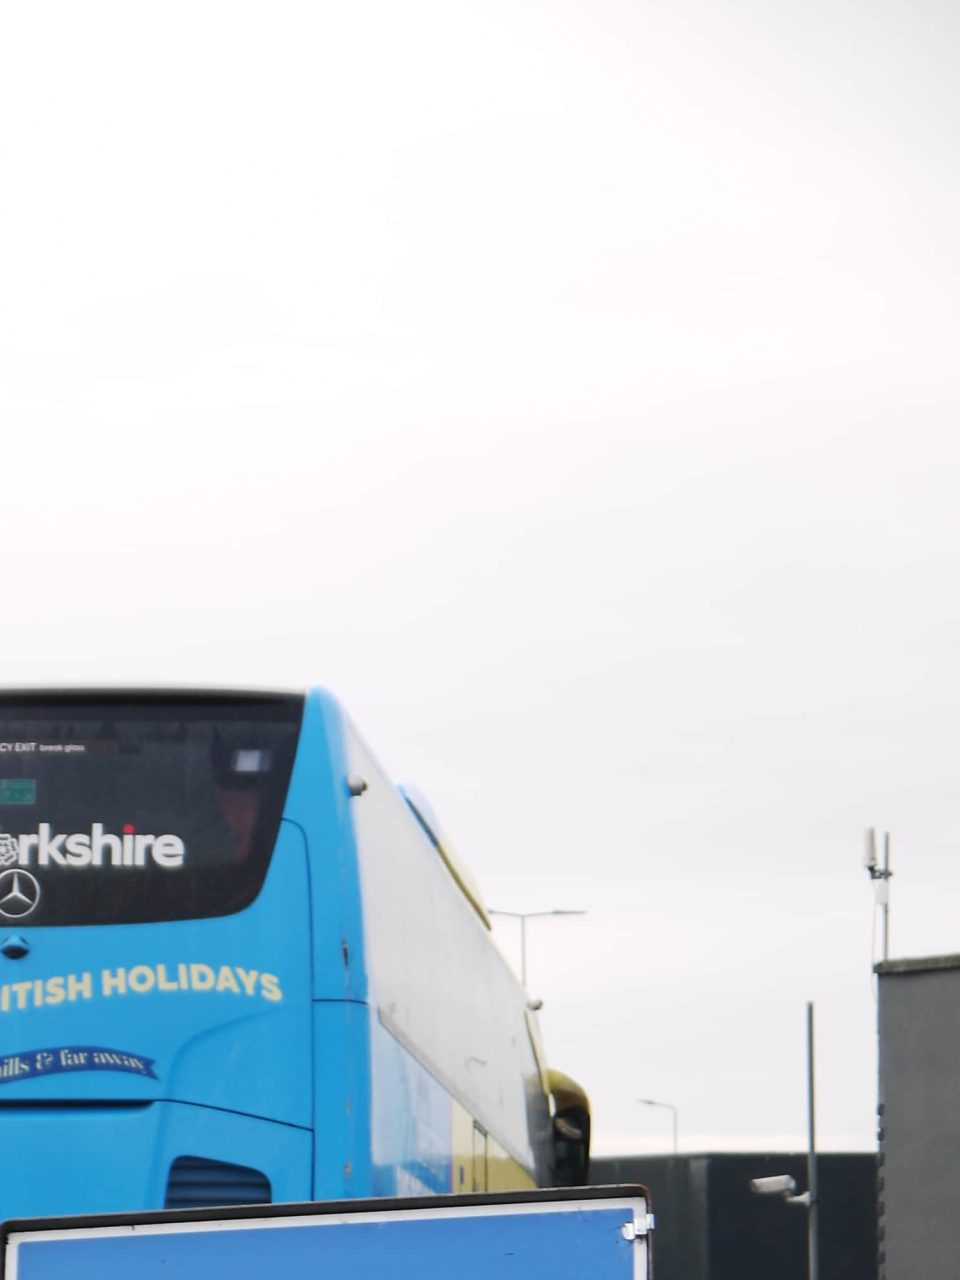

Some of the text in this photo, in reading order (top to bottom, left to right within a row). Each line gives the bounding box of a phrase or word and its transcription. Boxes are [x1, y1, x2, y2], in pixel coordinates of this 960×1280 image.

[15, 742, 37, 752] EXIT
[101, 963, 283, 1002] HOLIDAYS
[35, 1051, 54, 1071] &
[60, 1048, 89, 1067] far
[92, 1051, 147, 1075] away
